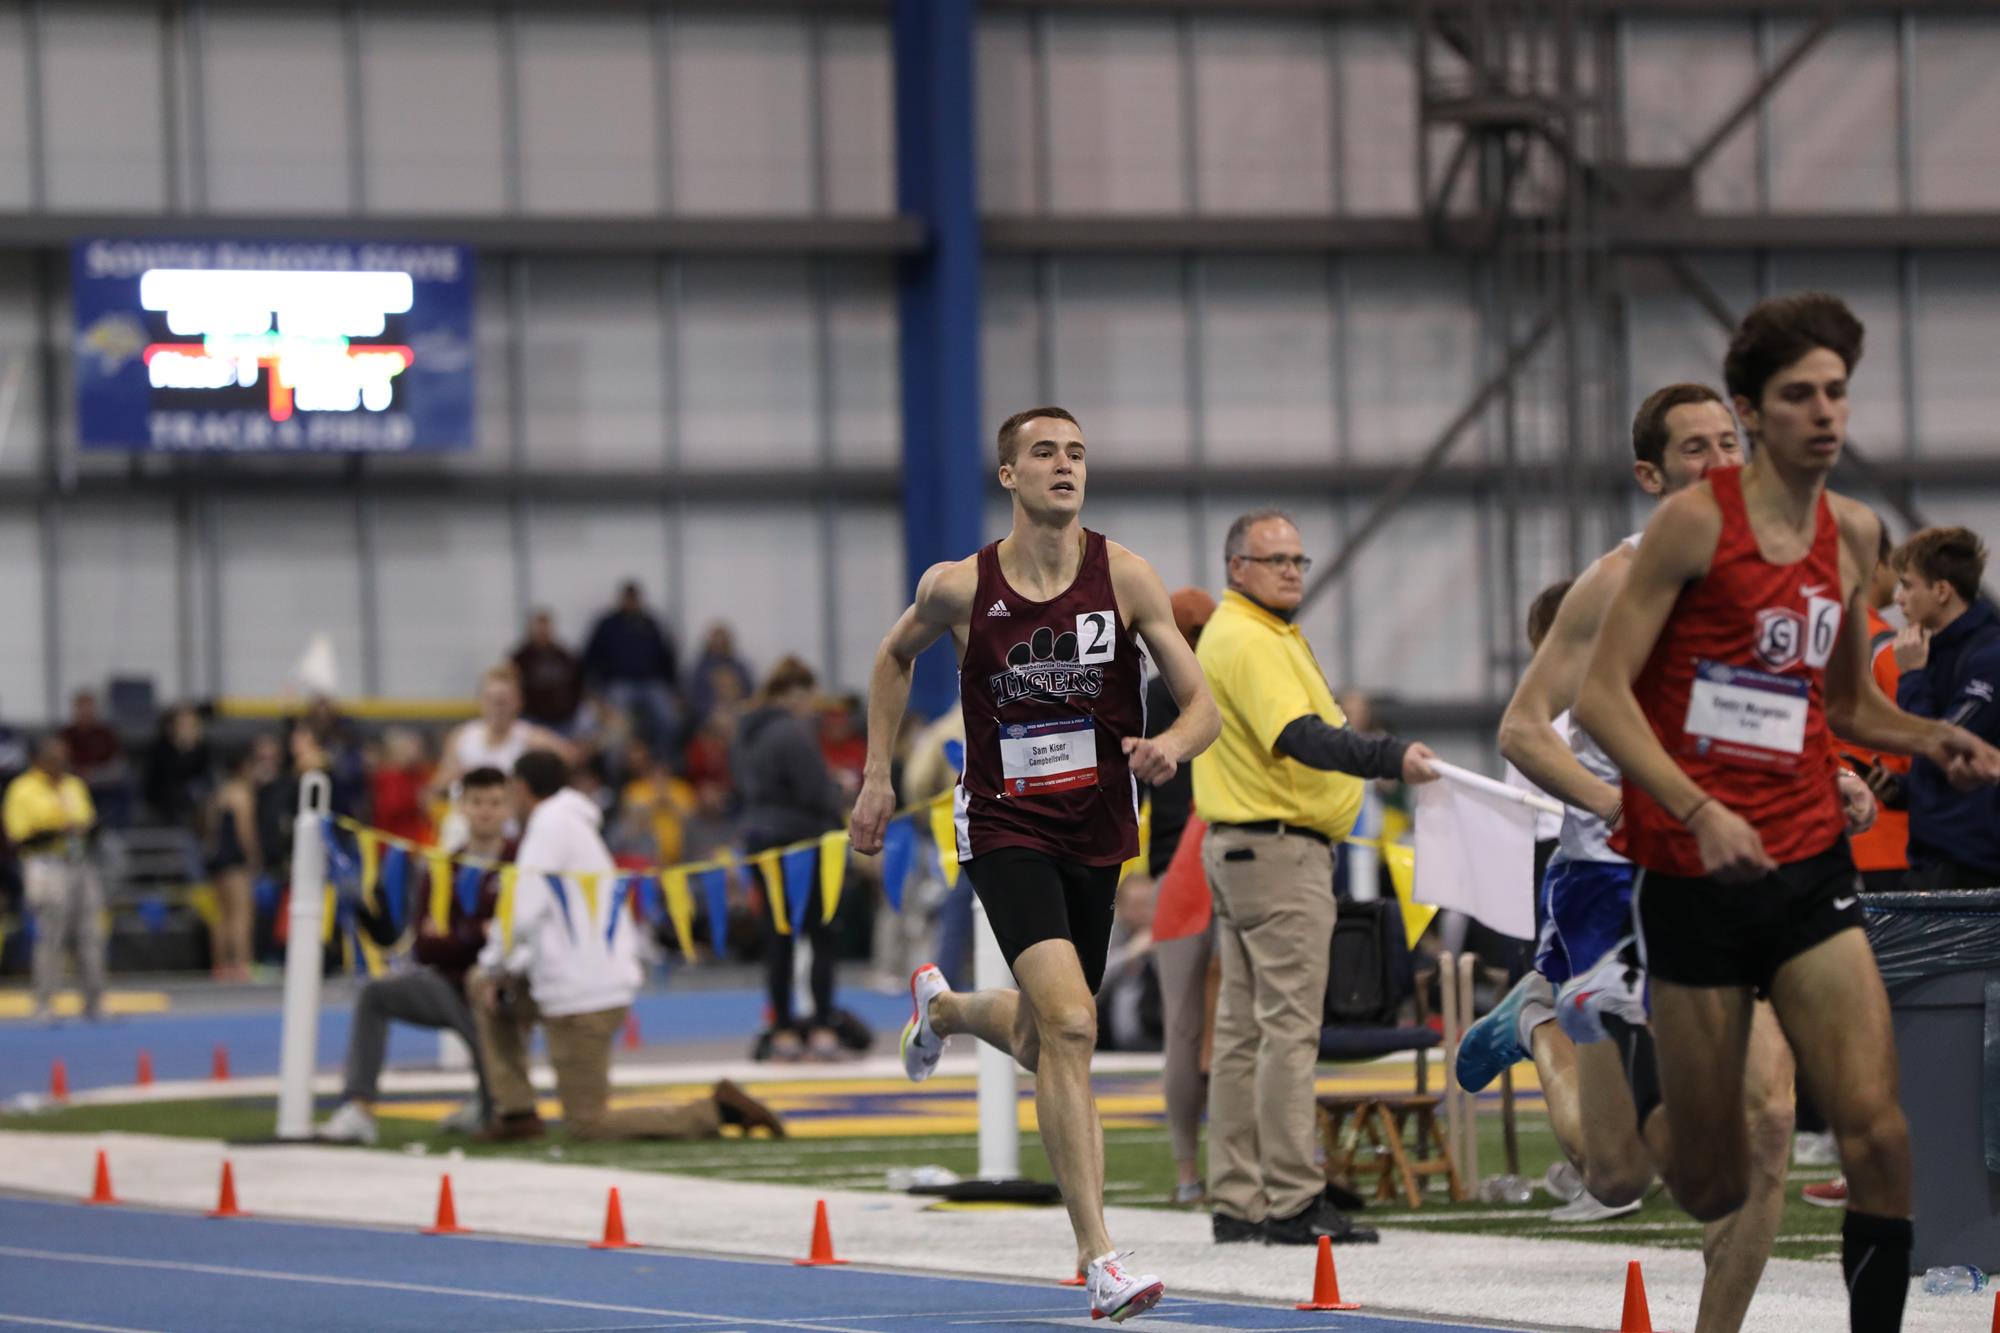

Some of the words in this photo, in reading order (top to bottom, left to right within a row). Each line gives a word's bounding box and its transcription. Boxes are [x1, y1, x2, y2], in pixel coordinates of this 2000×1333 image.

[1083, 613, 1109, 655] 2
[1814, 605, 1834, 656] 6
[991, 667, 1102, 703] TIGERS
[1029, 753, 1070, 766] Campbellsville
[1032, 746, 1047, 755] Sam
[1049, 743, 1066, 753] Kiser
